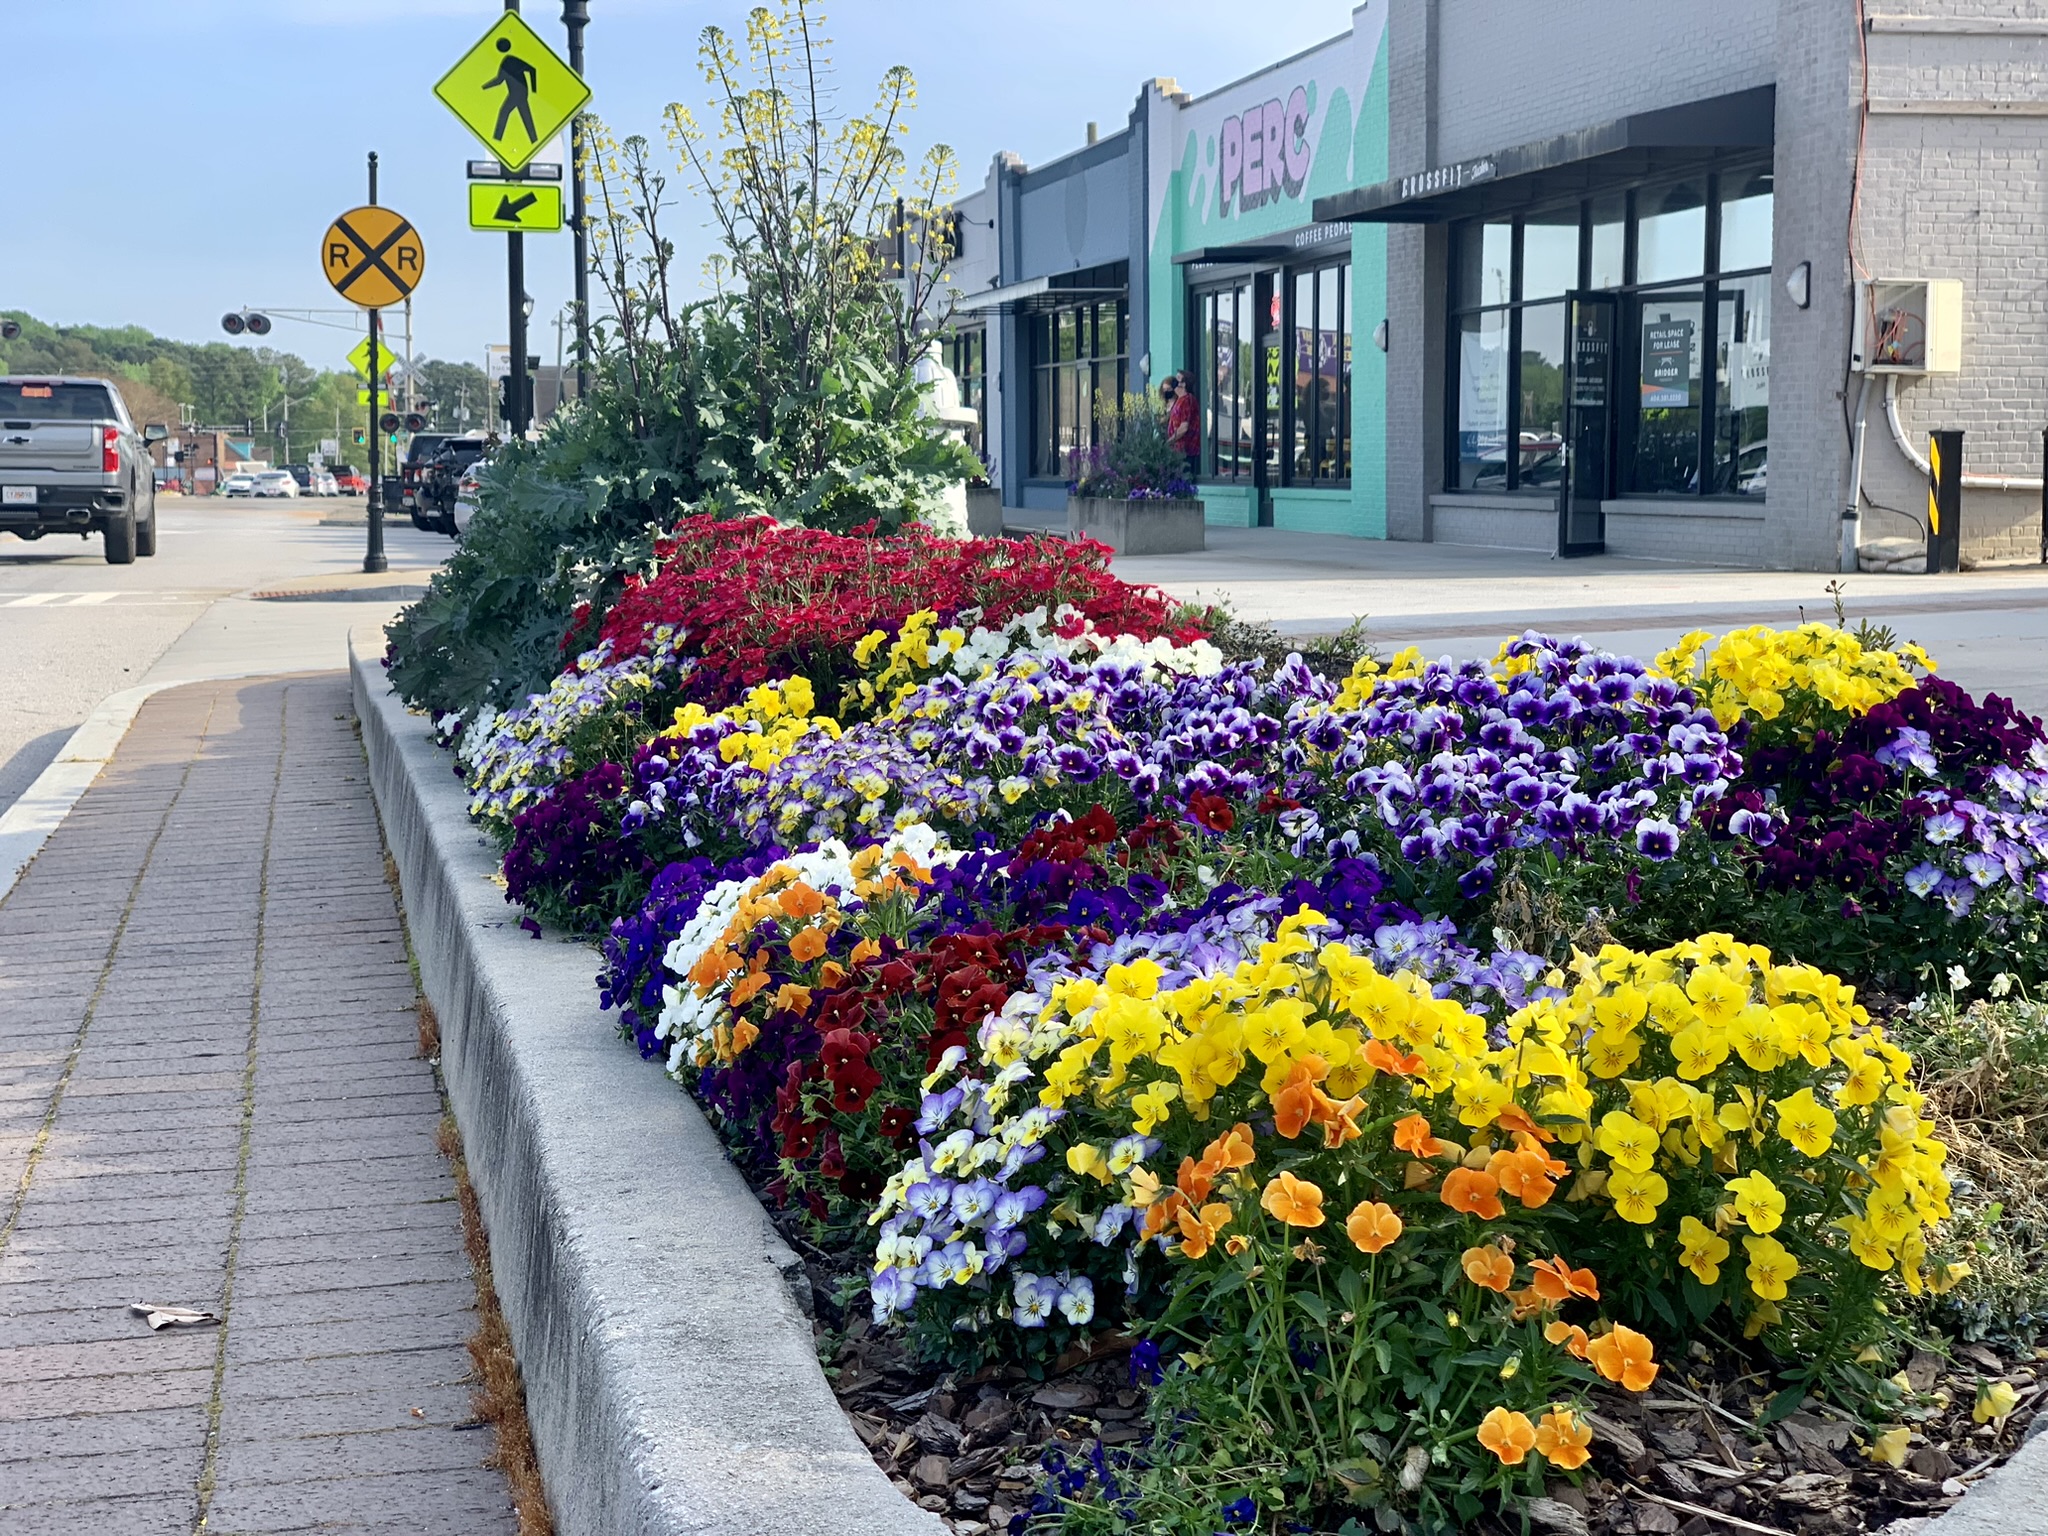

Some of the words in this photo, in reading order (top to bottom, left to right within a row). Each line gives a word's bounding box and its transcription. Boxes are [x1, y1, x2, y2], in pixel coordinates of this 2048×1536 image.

[1220, 85, 1310, 214] PERC
[1402, 164, 1462, 199] CROSSFIT
[1295, 222, 1323, 248] COFFEE
[1324, 221, 1353, 240] PEOPLE
[329, 243, 350, 268] R
[397, 246, 418, 271] R
[1650, 330, 1667, 340] RETAIL
[1667, 328, 1685, 338] SPACE
[1653, 341, 1664, 350] FOR
[1664, 340, 1681, 349] LEASE
[1654, 367, 1679, 378] BRIDGER
